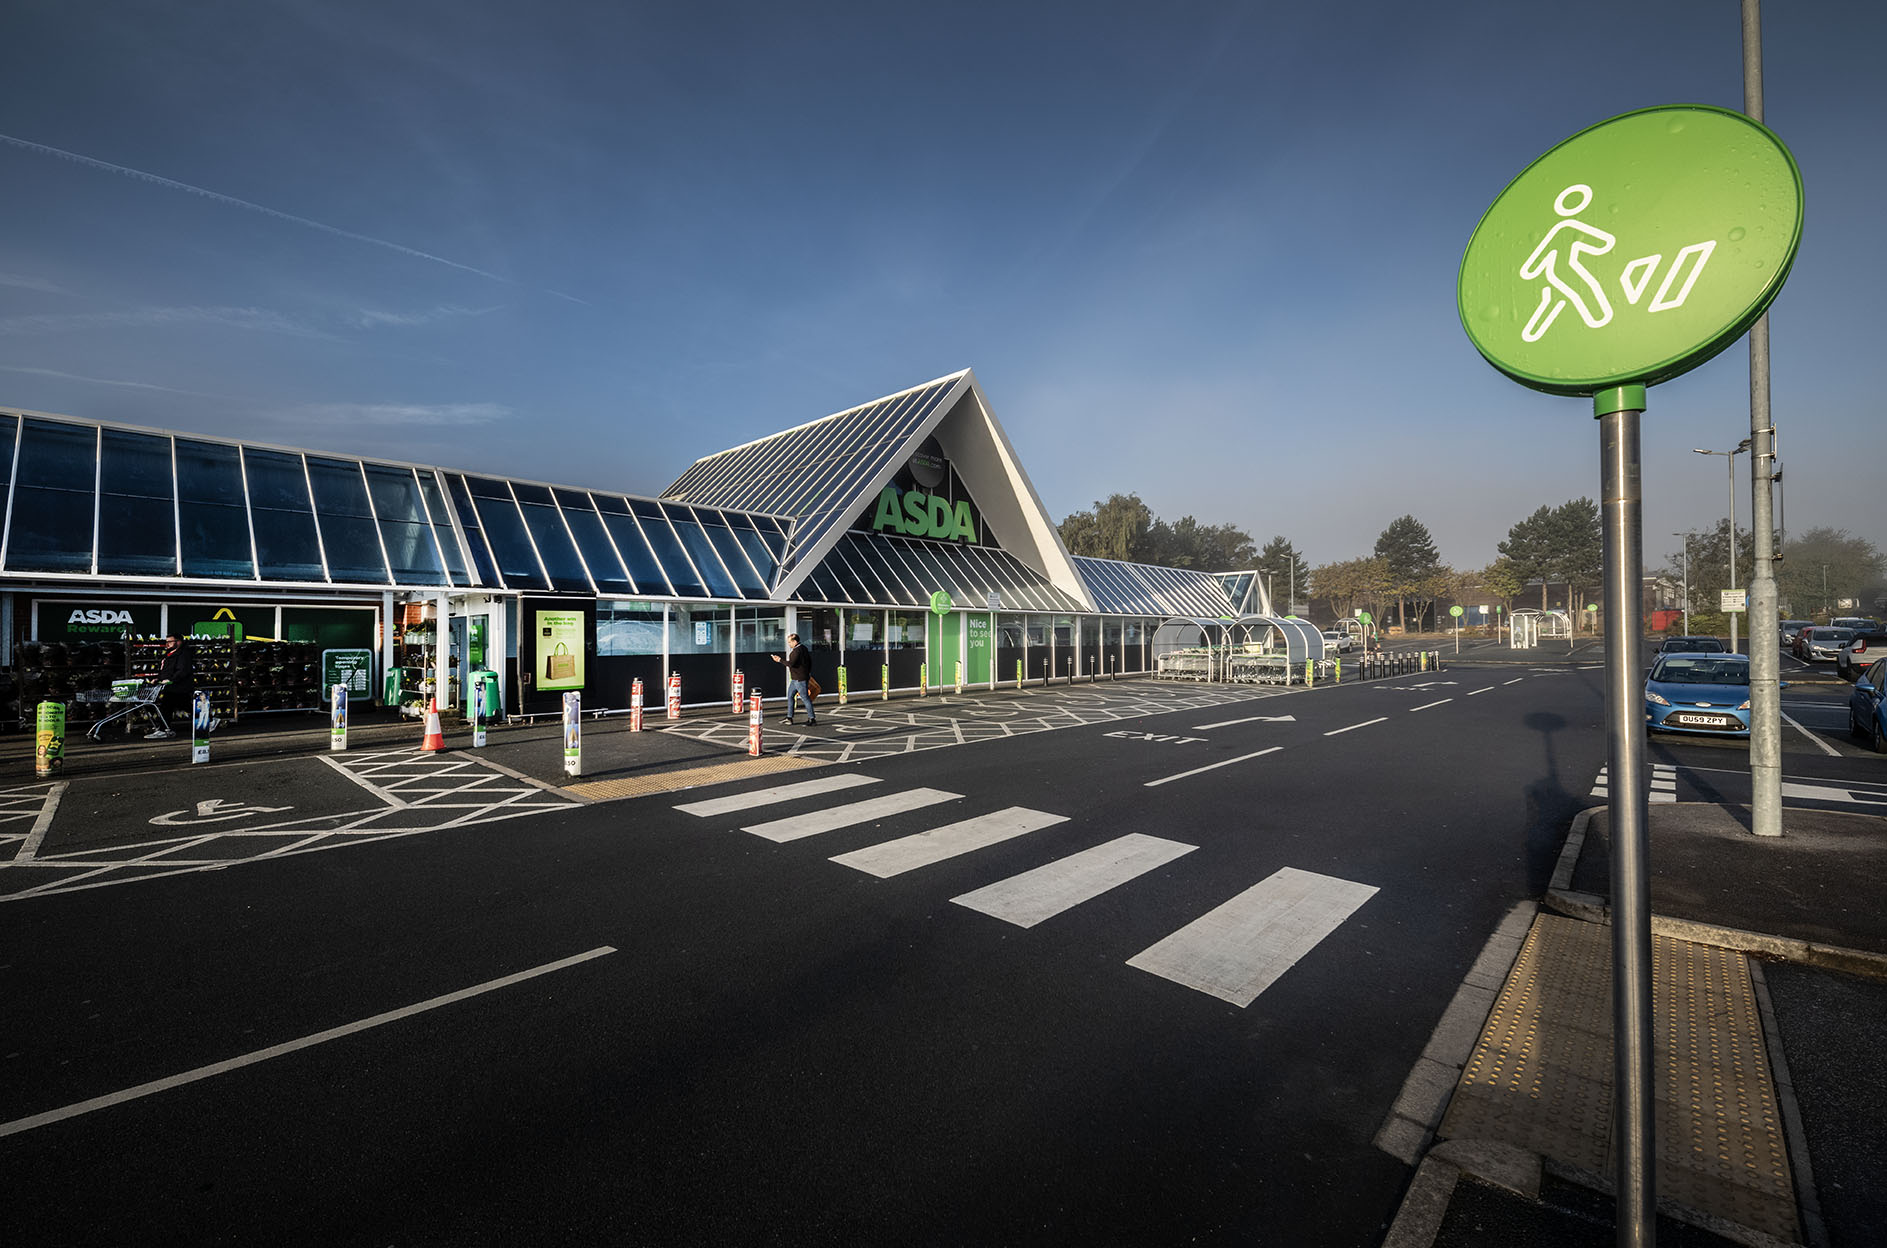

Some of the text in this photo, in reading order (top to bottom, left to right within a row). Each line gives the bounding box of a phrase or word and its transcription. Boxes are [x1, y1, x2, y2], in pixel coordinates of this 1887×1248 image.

[873, 487, 977, 544] ASDA
[67, 609, 134, 624] ASDA
[969, 619, 987, 629] Nice
[969, 629, 979, 638] to
[969, 639, 985, 649] you
[1682, 715, 1705, 723] OU59
